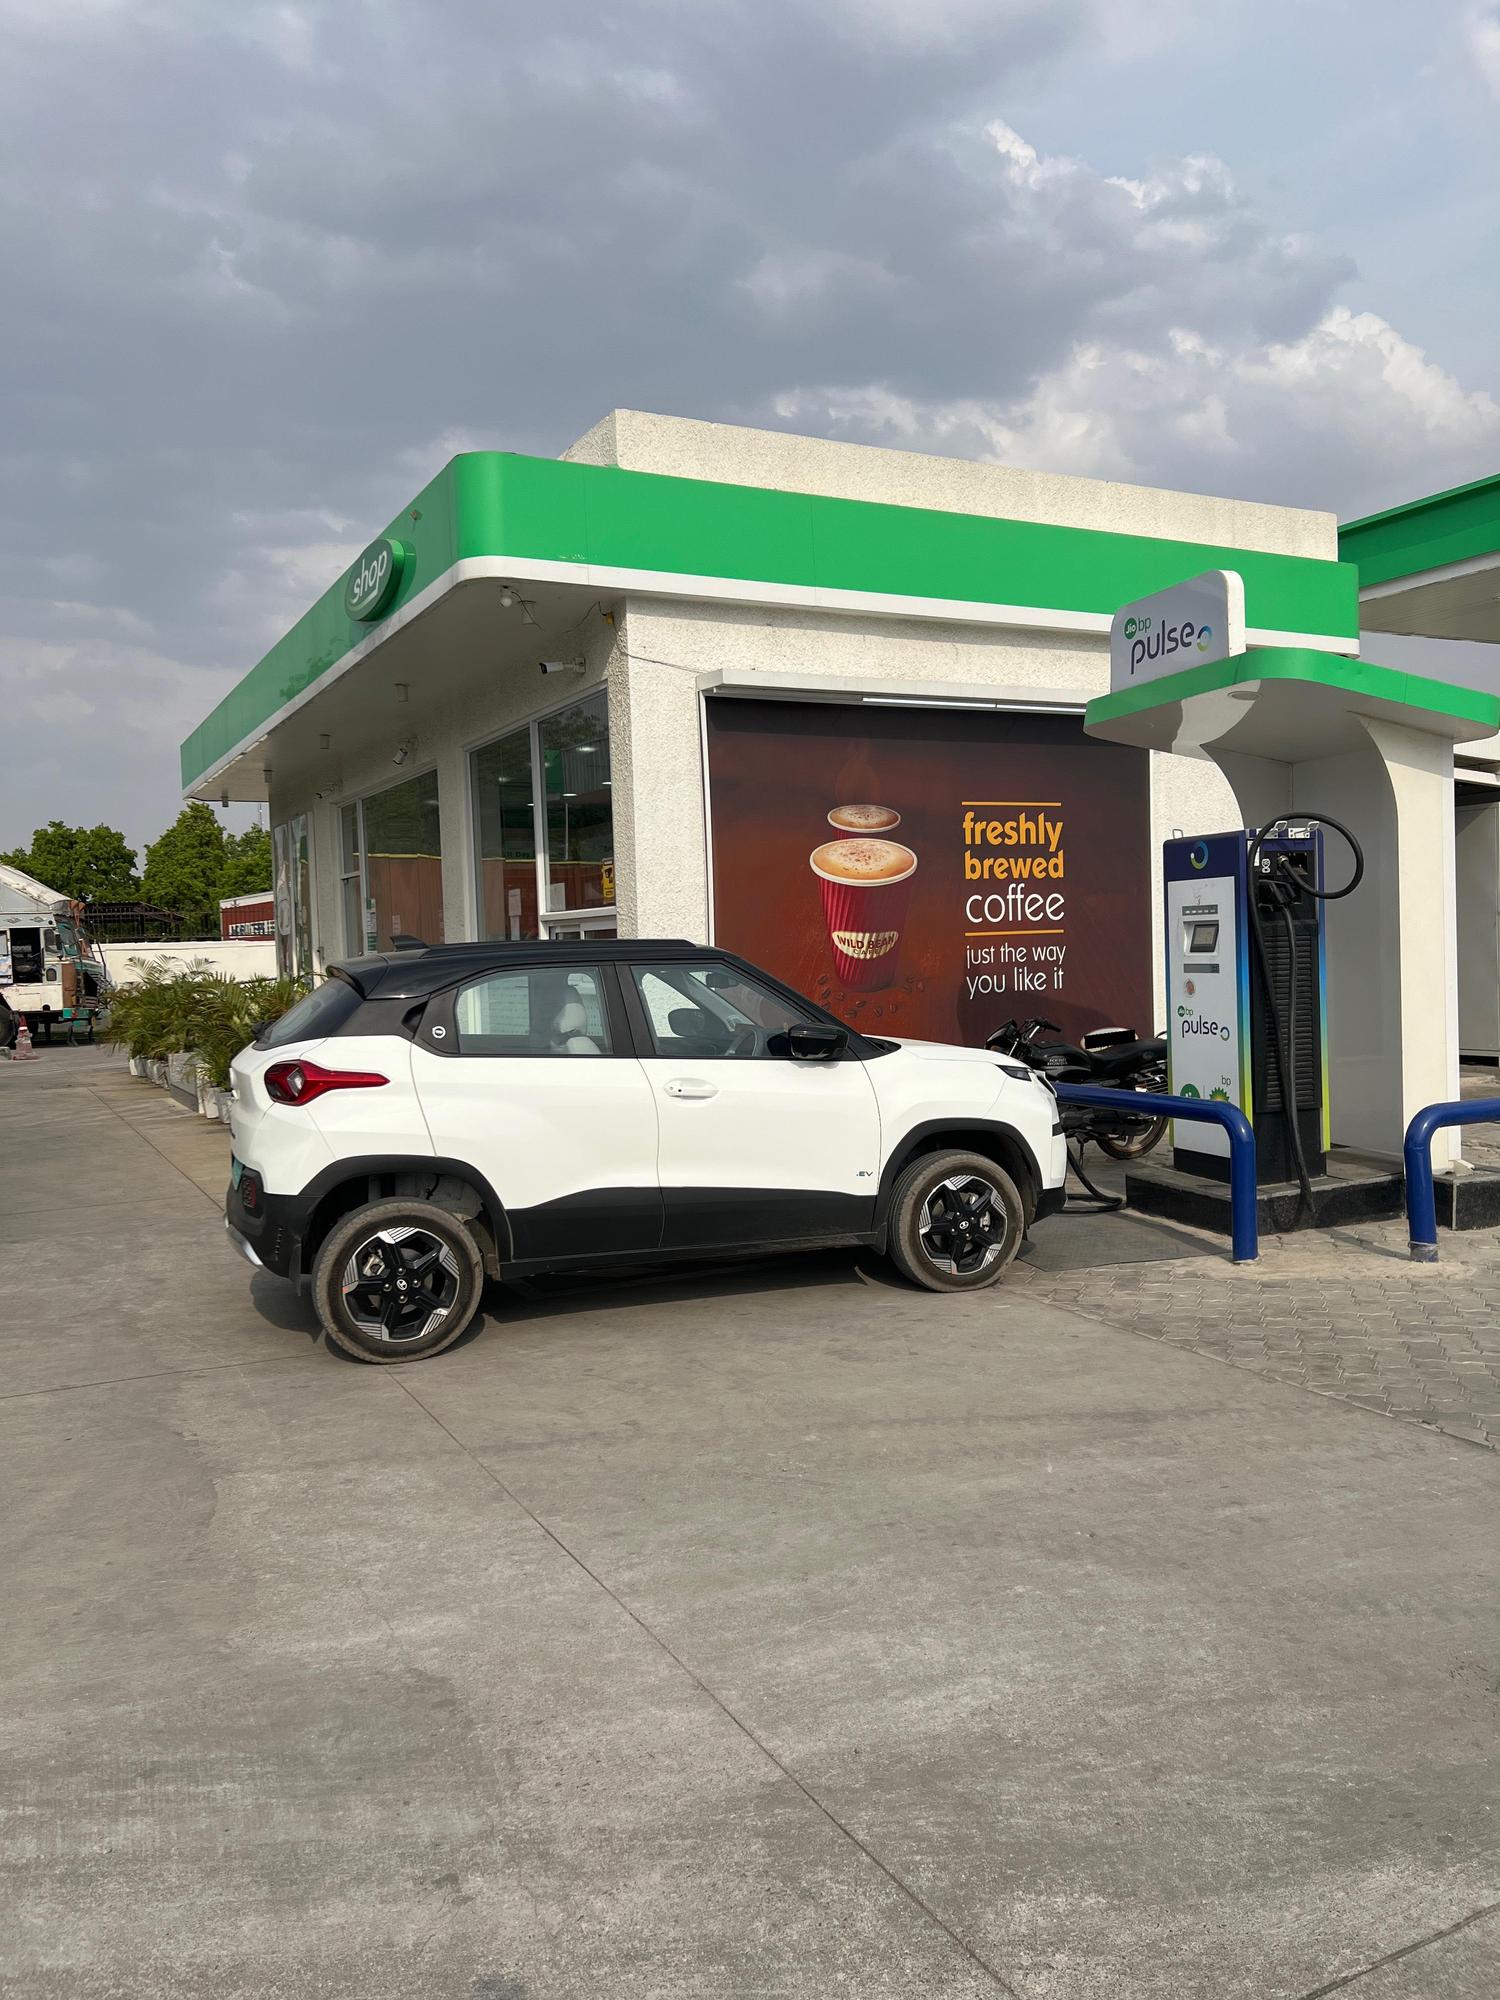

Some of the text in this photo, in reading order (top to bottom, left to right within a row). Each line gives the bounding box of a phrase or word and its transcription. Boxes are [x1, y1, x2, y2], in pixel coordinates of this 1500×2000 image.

[351, 550, 387, 604] shop
[1138, 617, 1152, 633] bp
[1131, 619, 1195, 675] pulse
[962, 811, 1064, 852] freshly
[964, 850, 1064, 880] brewed
[965, 883, 1065, 923] coffee
[837, 933, 895, 950] WILD BEAN
[966, 942, 1066, 969] just the way
[966, 966, 1064, 1000] you like it
[1181, 1014, 1218, 1038] pulse
[1185, 1007, 1194, 1017] bp
[1221, 1075, 1232, 1087] bp
